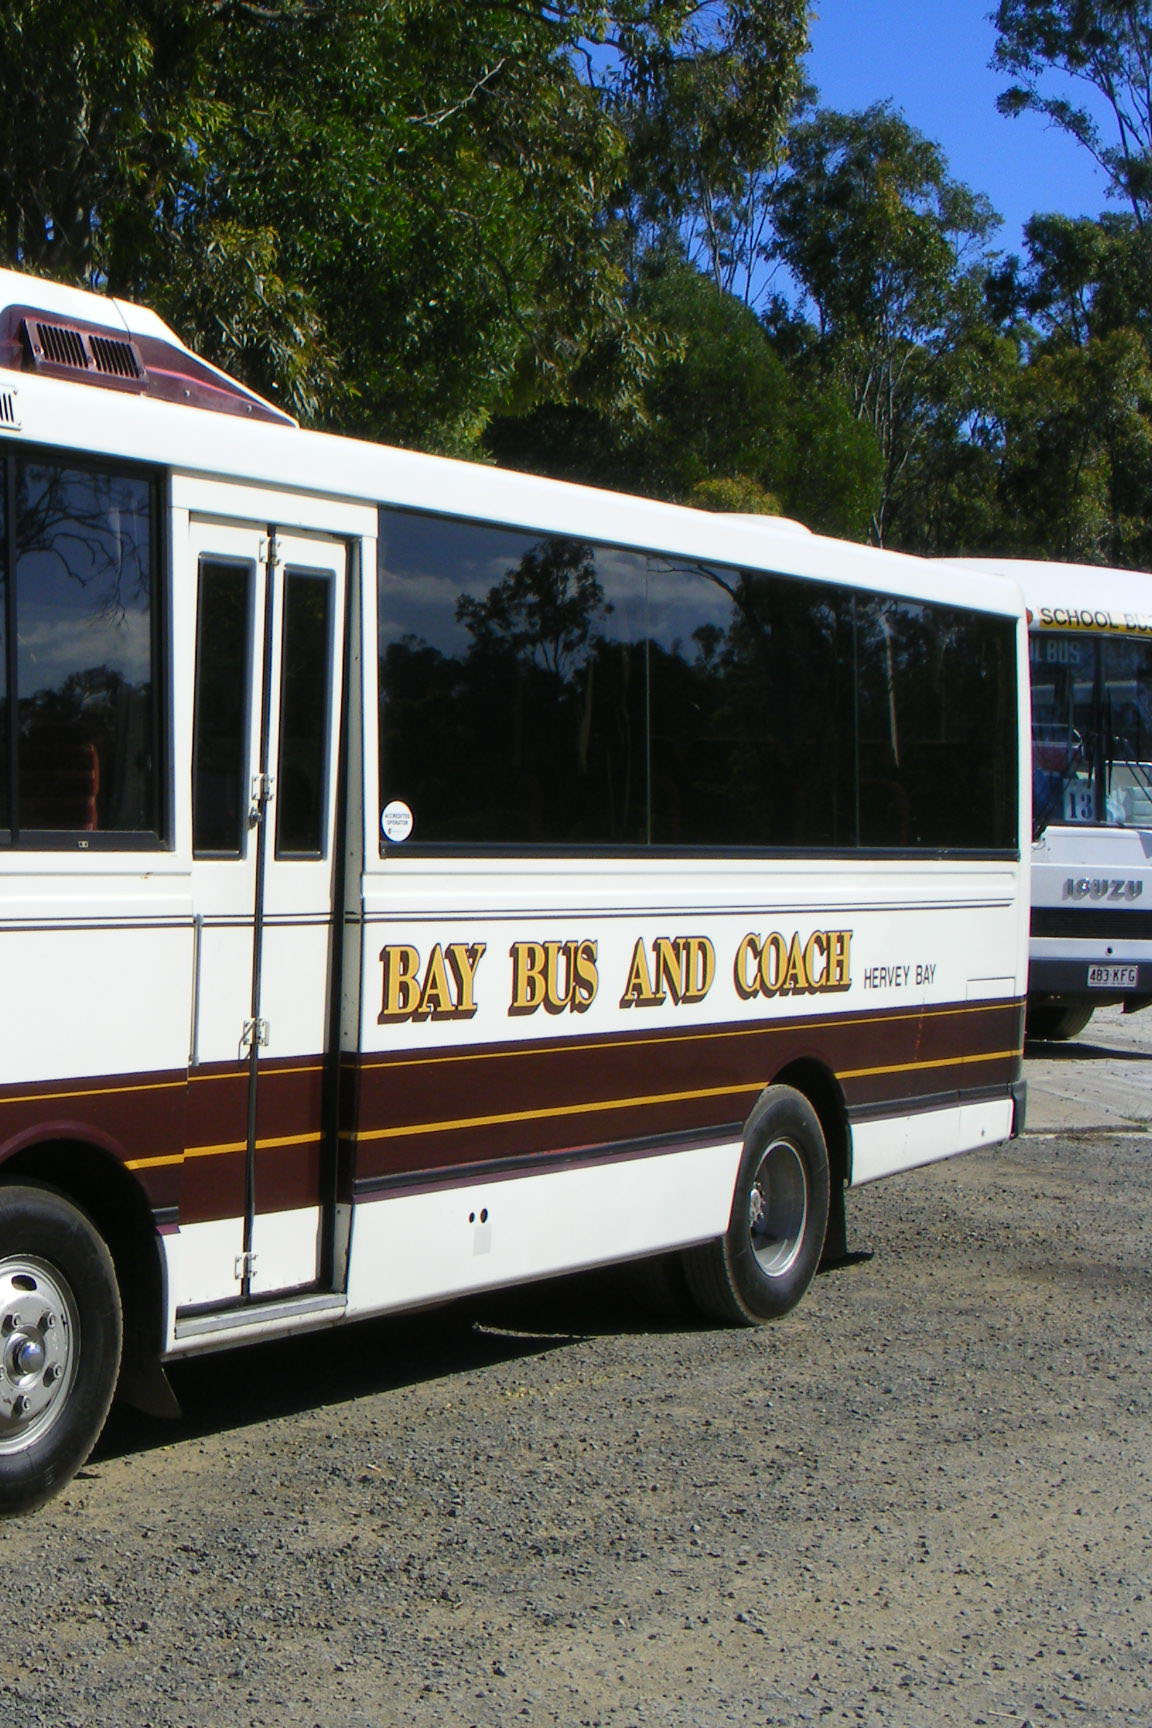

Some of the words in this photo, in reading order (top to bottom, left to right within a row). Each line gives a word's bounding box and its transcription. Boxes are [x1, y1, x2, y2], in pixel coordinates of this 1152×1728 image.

[1040, 608, 1119, 629] SCHOOL
[1124, 613, 1152, 632] BU
[1069, 792, 1093, 820] 13
[1066, 878, 1143, 898] ISUZU
[377, 943, 487, 1025] BAY
[508, 939, 598, 1016] BUS
[619, 936, 716, 1008] AND
[733, 930, 853, 1000] COACH
[863, 965, 910, 989] HERVEY
[915, 964, 937, 986] BAY
[1090, 967, 1109, 982] 483
[1113, 967, 1135, 982] KFG
